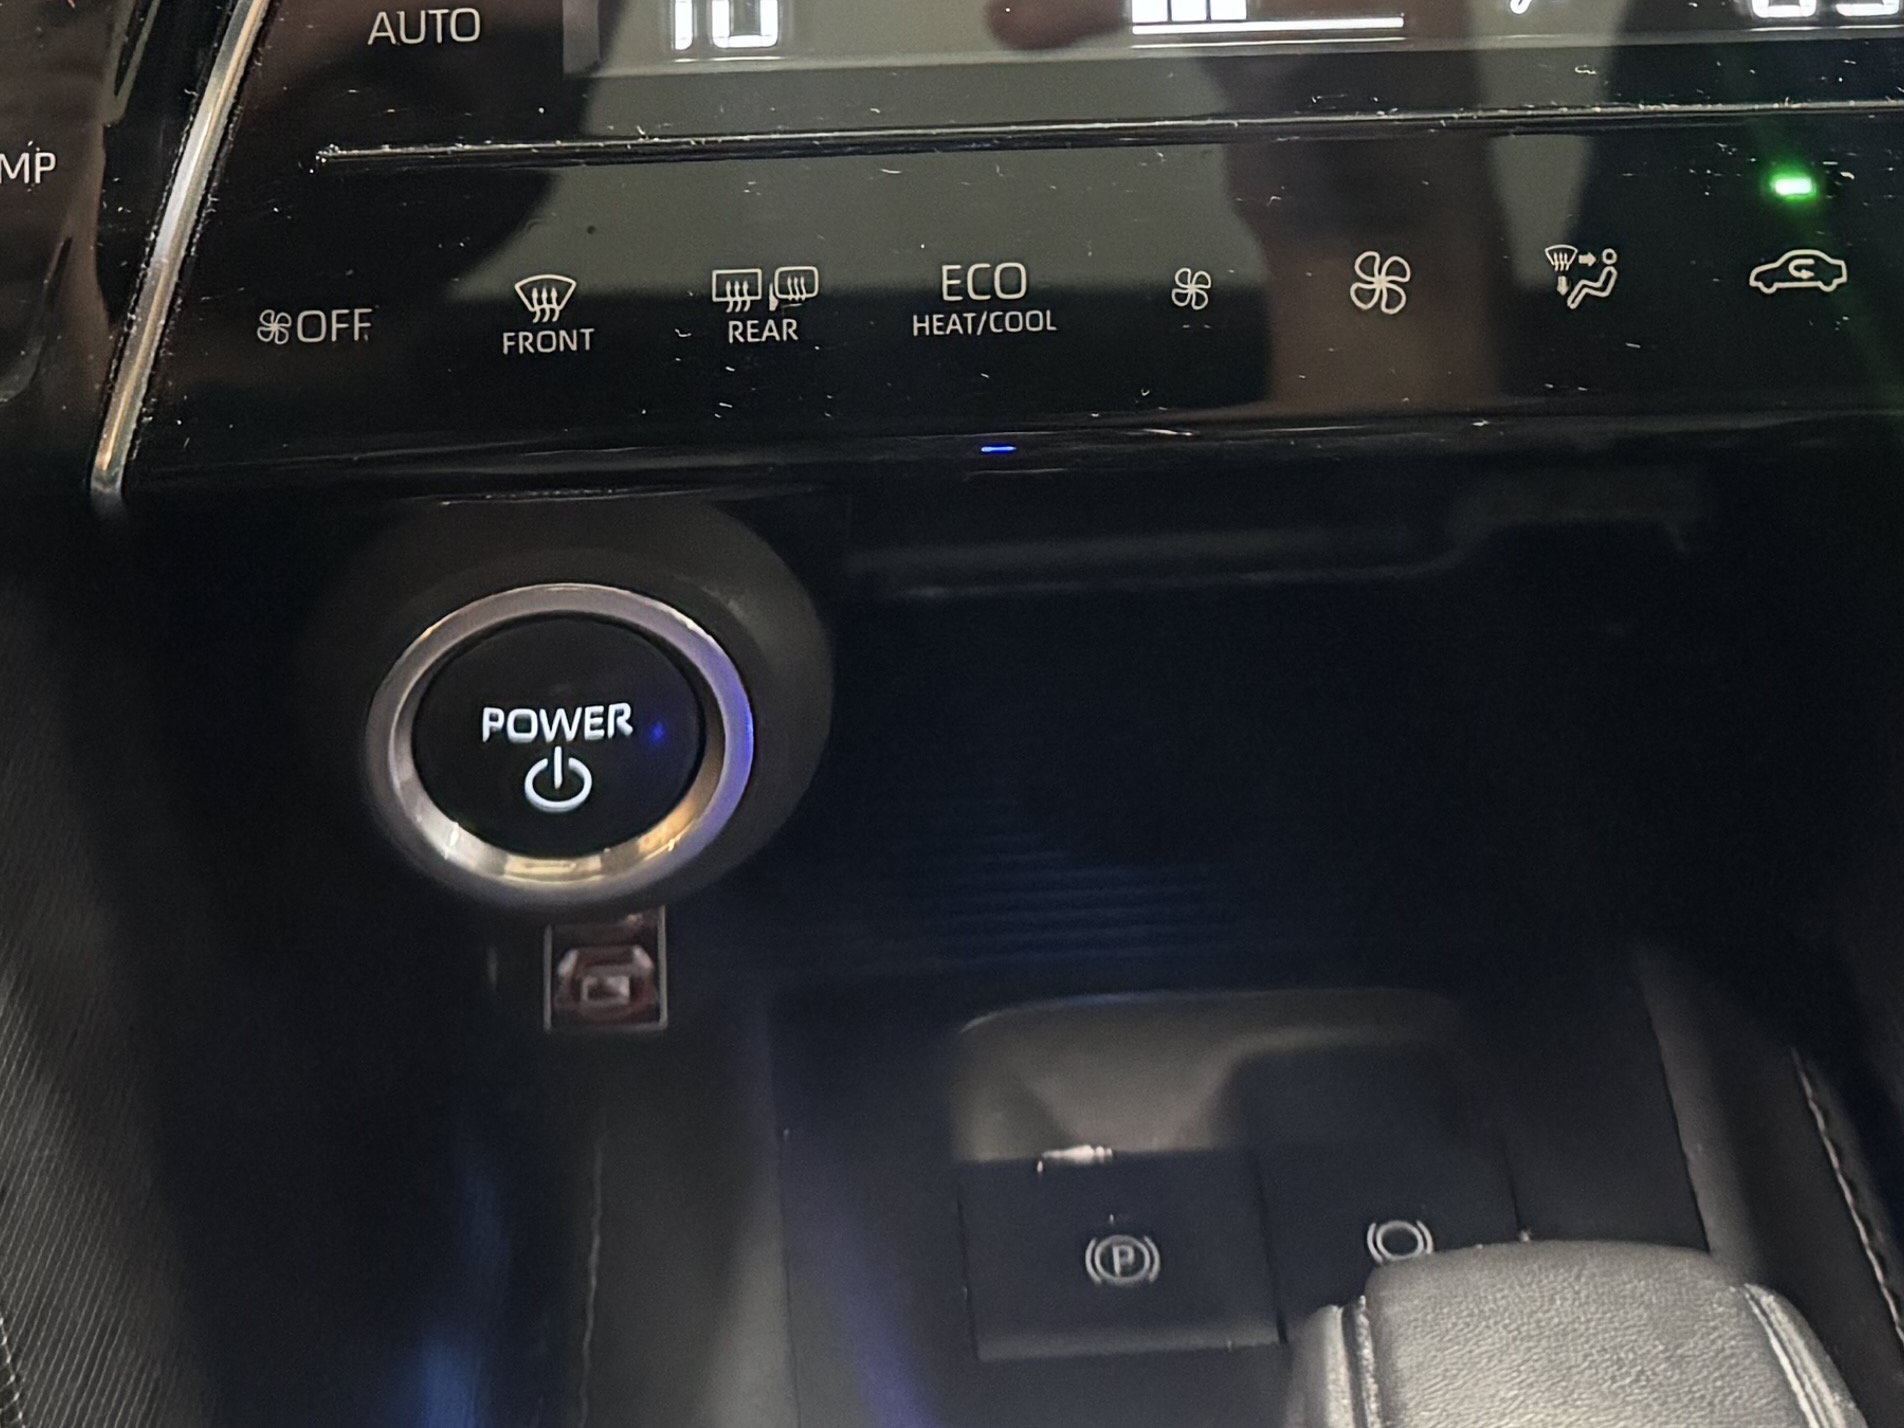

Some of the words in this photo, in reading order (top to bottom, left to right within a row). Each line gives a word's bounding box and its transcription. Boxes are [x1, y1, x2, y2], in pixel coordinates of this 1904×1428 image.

[368, 8, 480, 44] AUTO
[942, 262, 1026, 300] ECO
[297, 309, 371, 342] OFF
[729, 319, 798, 343] REAR
[913, 310, 1056, 336] HEAT/COOL
[503, 329, 594, 354] FRONT
[482, 702, 633, 744] POWER
